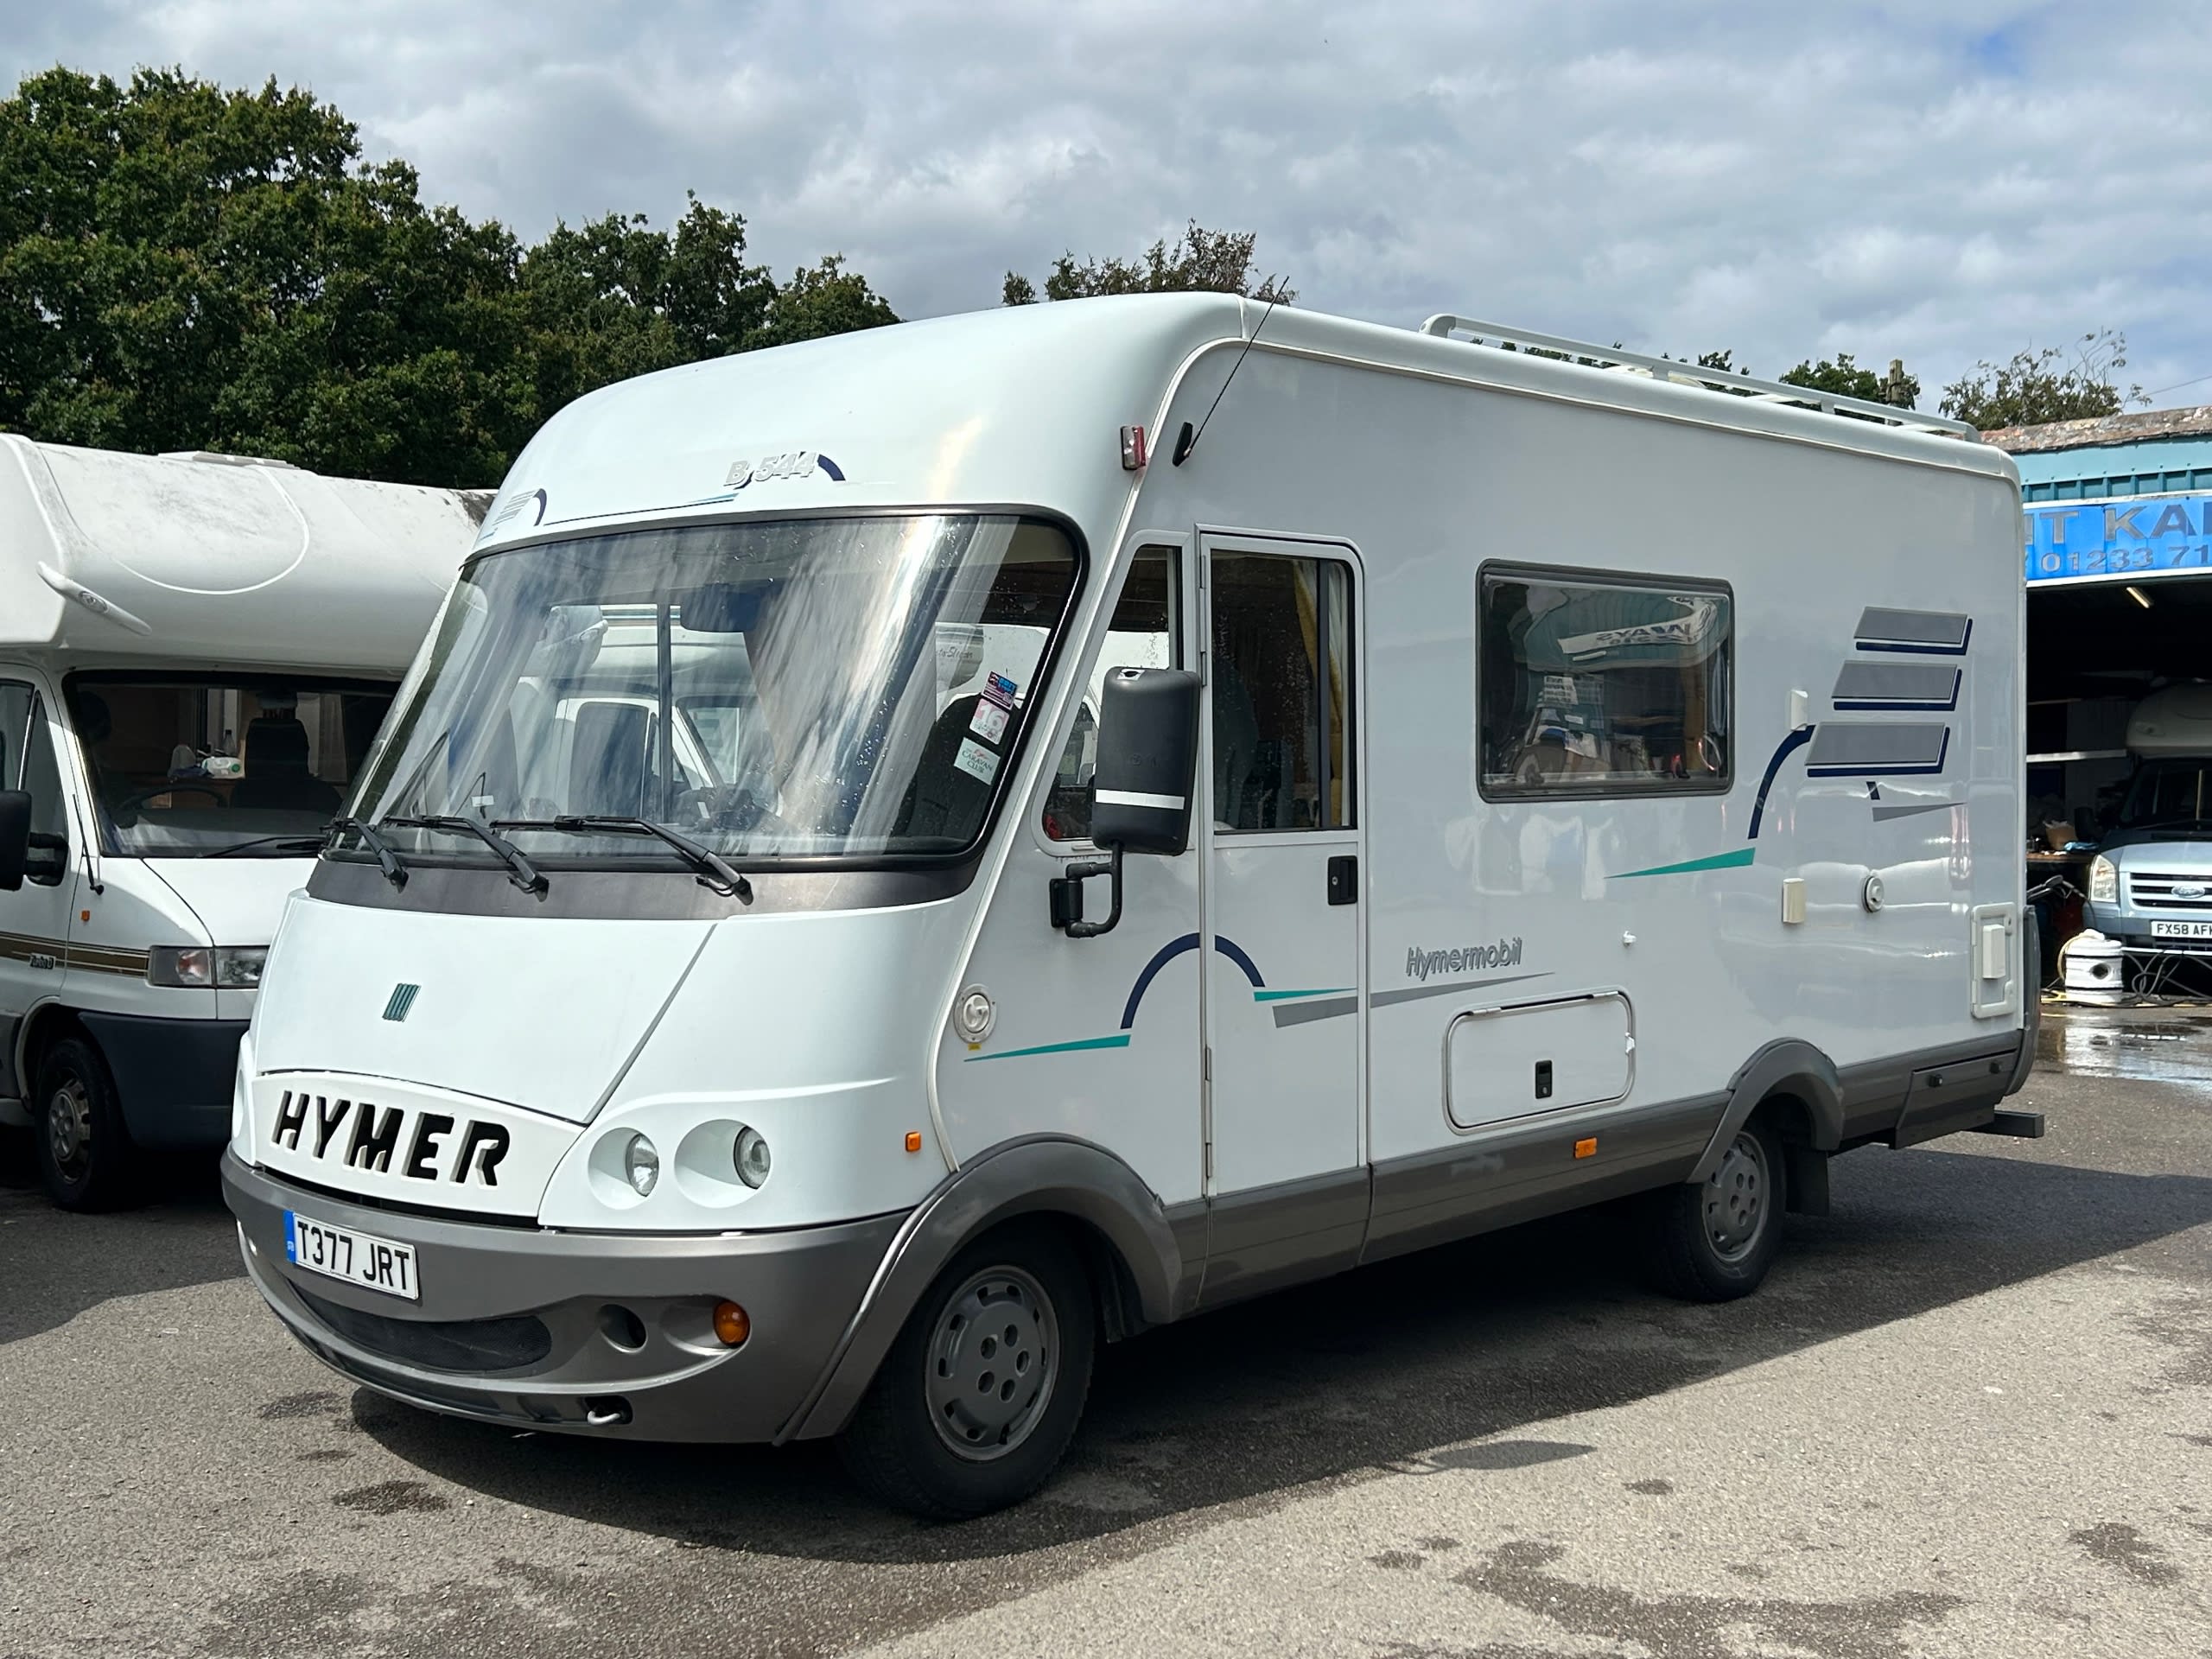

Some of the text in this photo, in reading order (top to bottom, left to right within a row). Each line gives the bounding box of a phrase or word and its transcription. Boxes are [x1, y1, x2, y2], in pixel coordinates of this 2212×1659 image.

[754, 451, 817, 482] 544
[2041, 543, 2209, 573] 01233 71
[2157, 923, 2190, 935] FX58
[1406, 937, 1522, 982] Hymermobil
[270, 1090, 512, 1186] HYMER
[297, 1220, 410, 1290] T377 JRT
